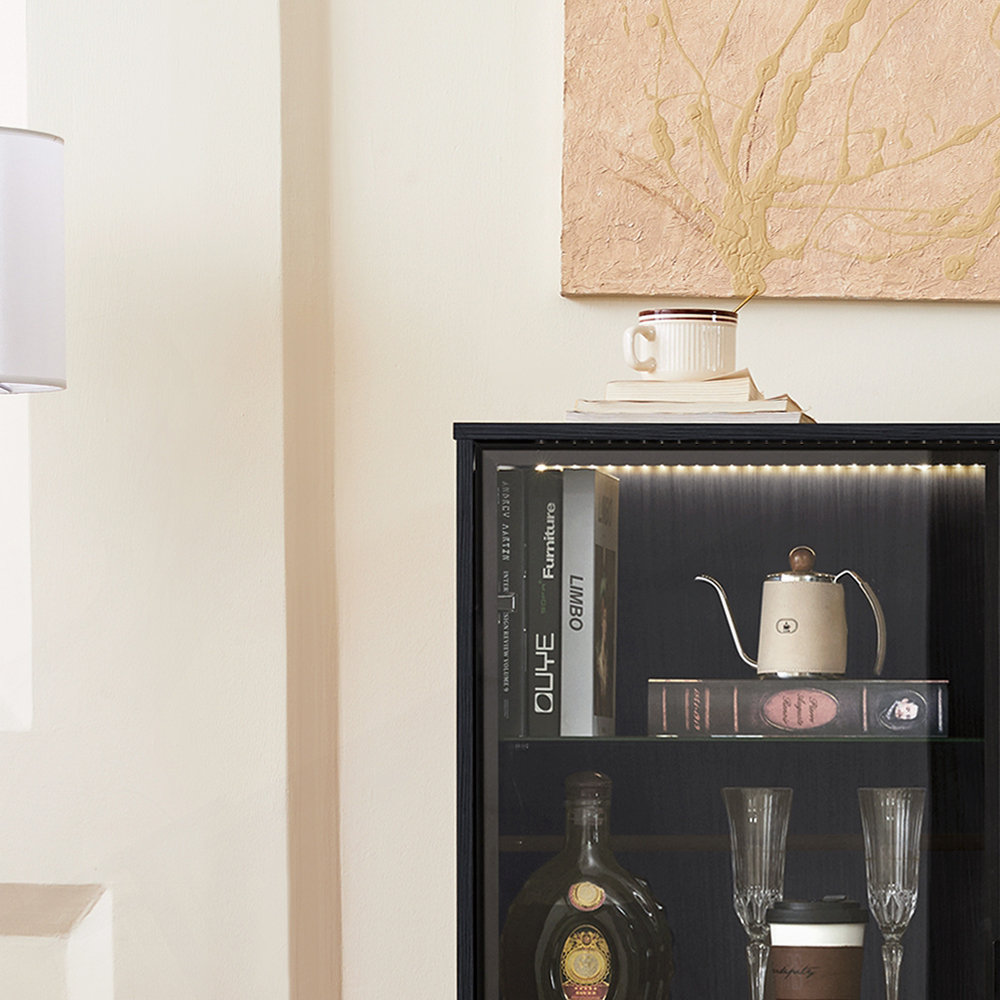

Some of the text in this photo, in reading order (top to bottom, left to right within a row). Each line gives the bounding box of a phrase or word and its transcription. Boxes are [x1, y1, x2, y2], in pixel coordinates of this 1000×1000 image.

[541, 502, 556, 579] Furniture
[569, 574, 583, 632] LIMBO
[502, 631, 511, 658] REVIEW
[502, 658, 511, 686] VOLUME
